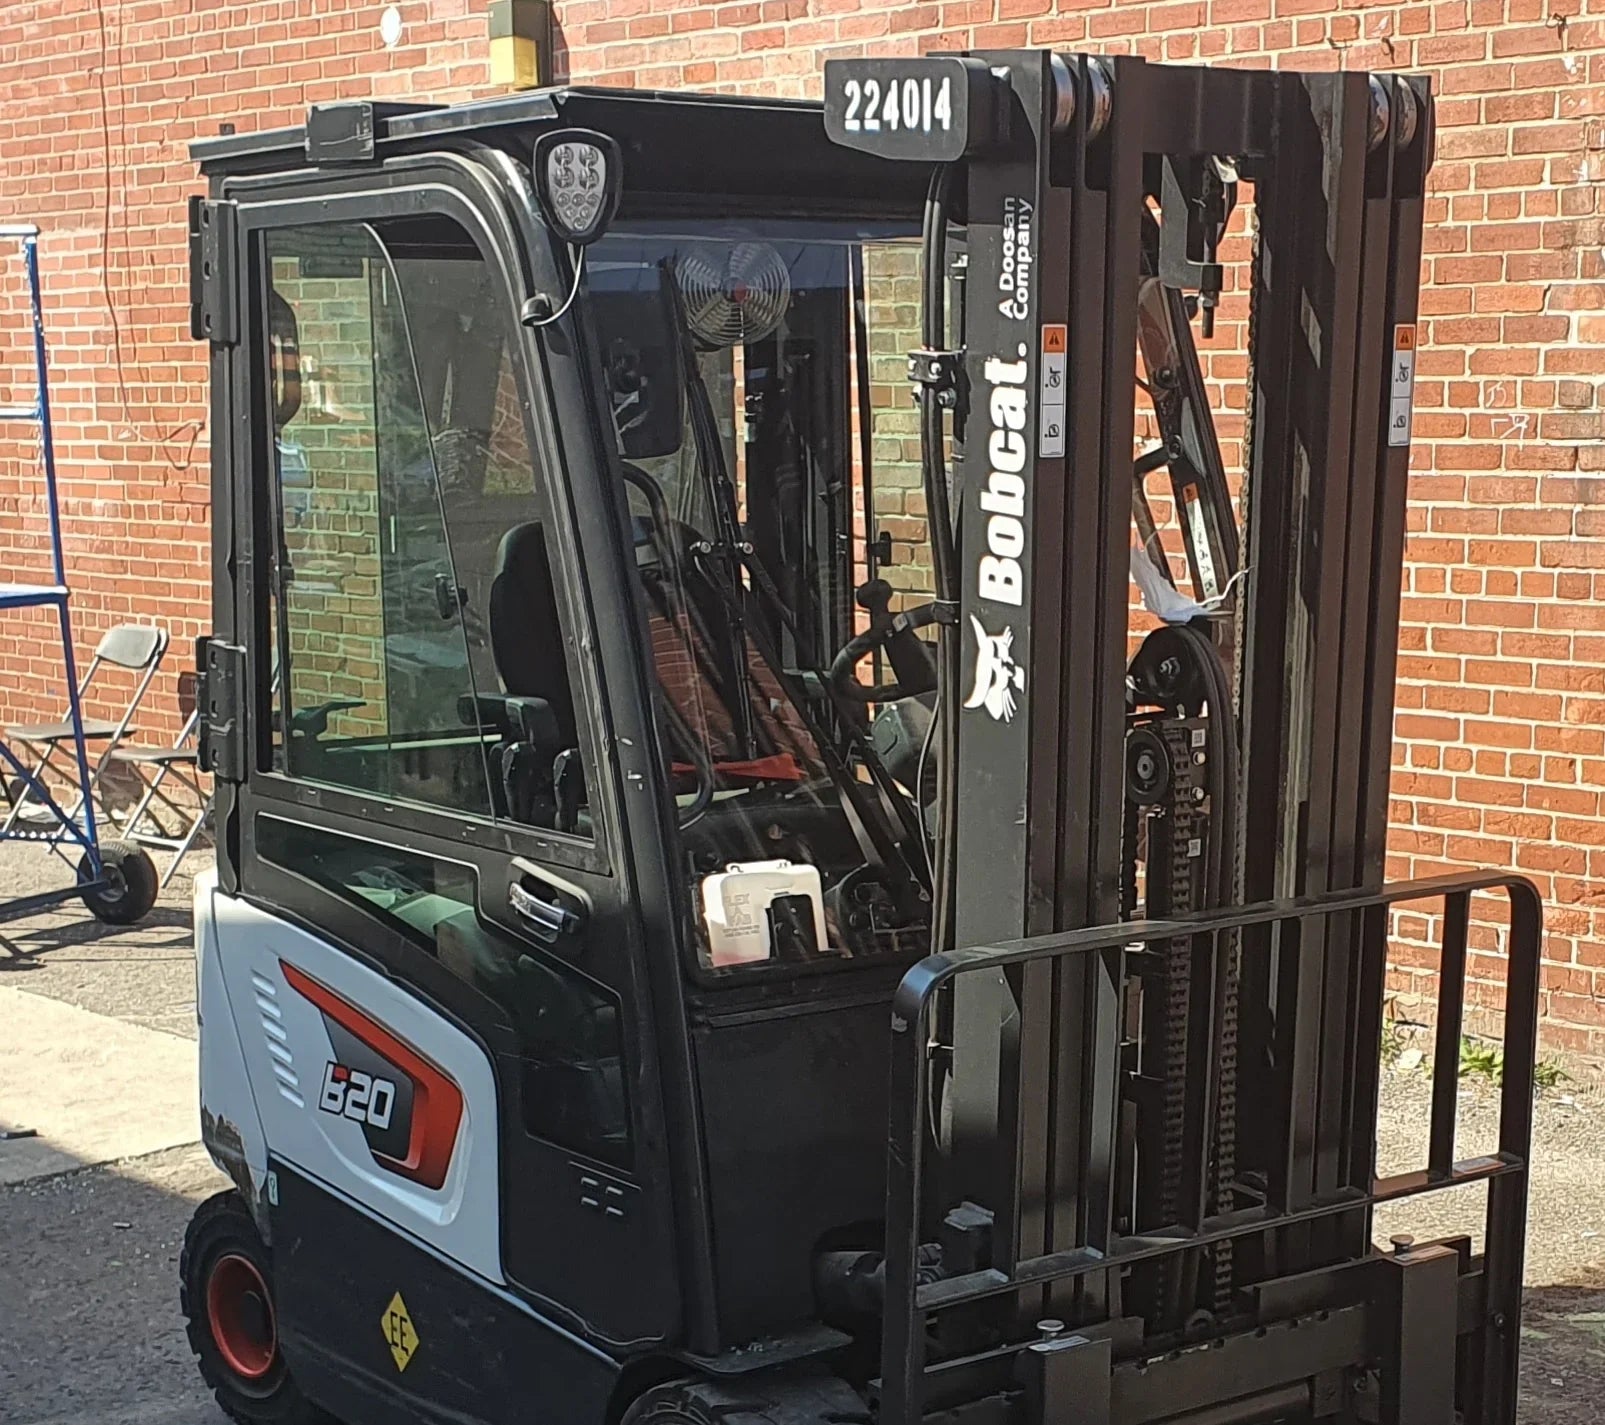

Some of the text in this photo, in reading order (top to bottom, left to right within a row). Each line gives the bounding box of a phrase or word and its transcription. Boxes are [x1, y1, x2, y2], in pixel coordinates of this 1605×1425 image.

[844, 77, 951, 132] 224014
[999, 196, 1015, 319] A Doosan
[1013, 198, 1033, 321] Company
[319, 1060, 396, 1131] B20
[390, 1310, 409, 1356] EE
